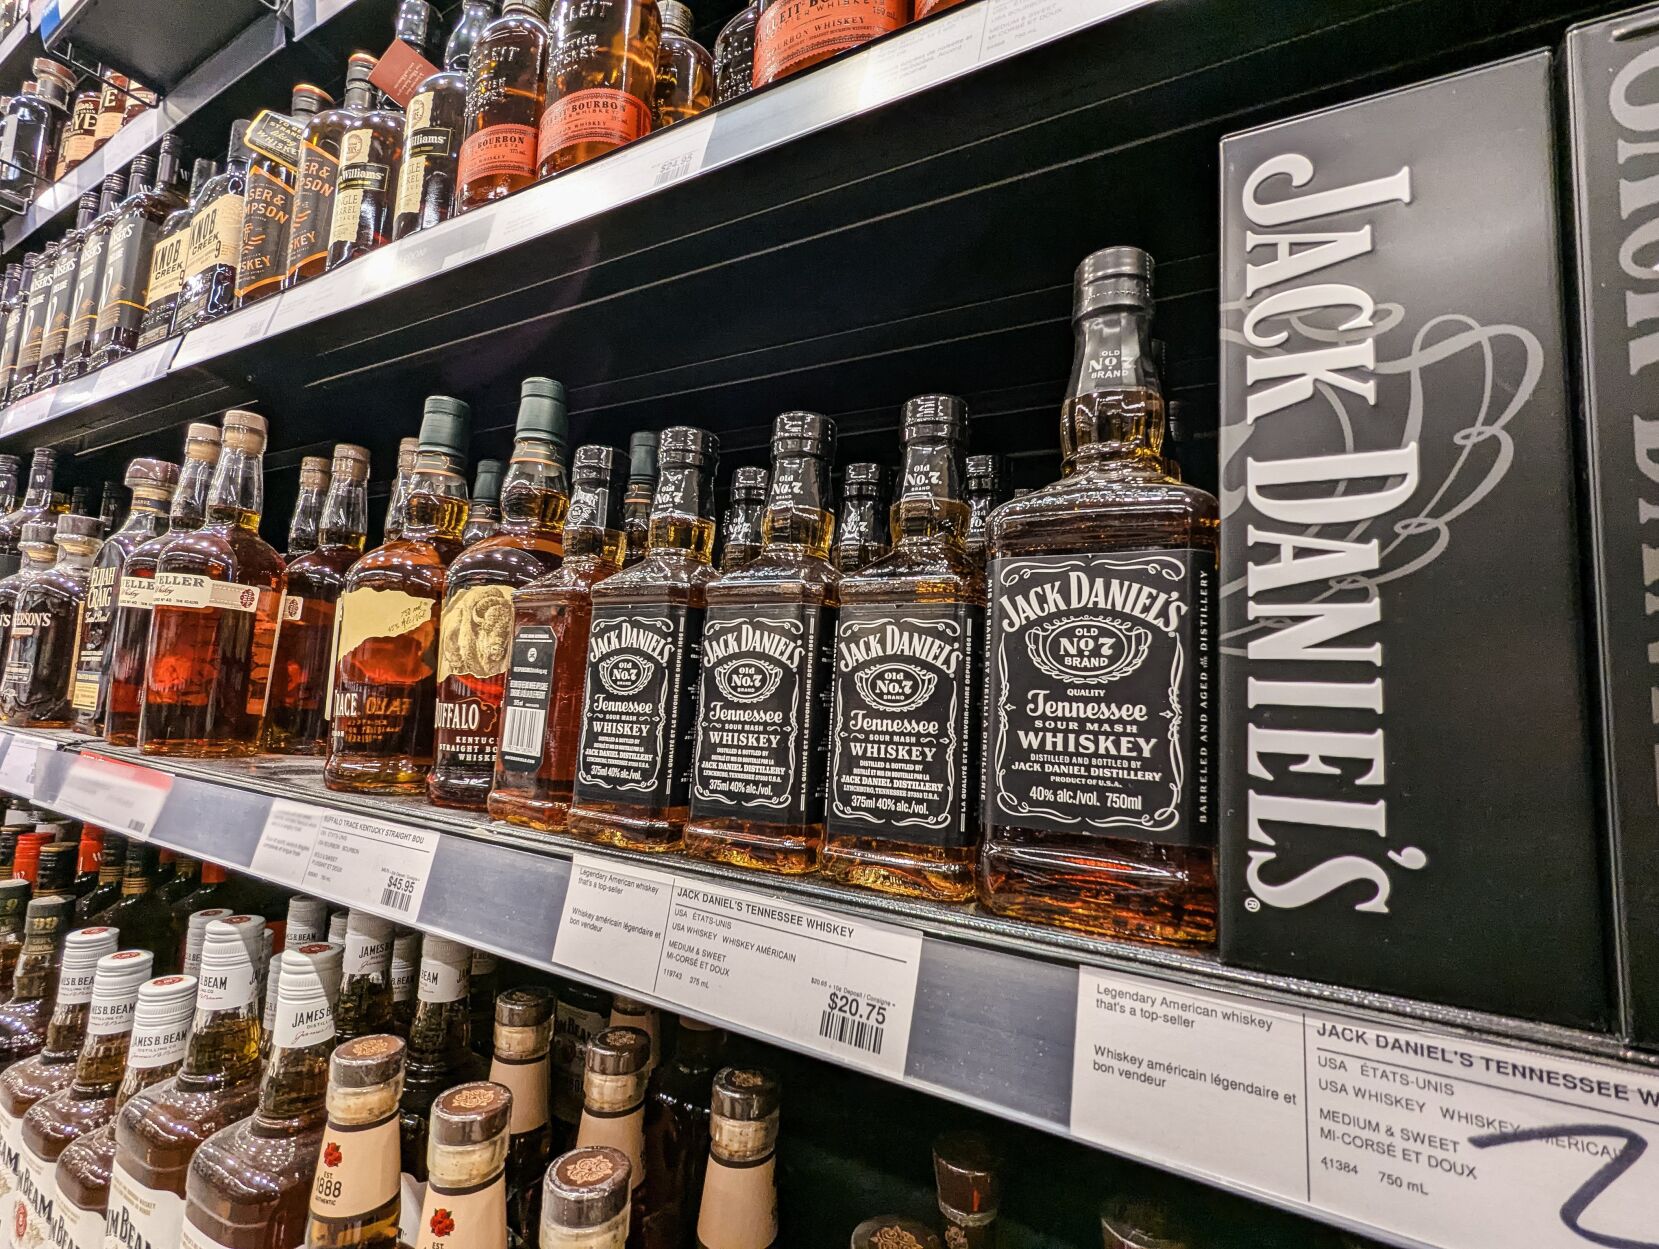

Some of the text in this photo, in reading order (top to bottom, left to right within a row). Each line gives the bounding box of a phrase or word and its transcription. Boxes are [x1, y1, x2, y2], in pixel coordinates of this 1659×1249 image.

[257, 130, 301, 155] WHISKE
[477, 136, 524, 148] BOURBON
[190, 207, 217, 245] KNOB
[192, 231, 218, 256] CREEK
[152, 239, 181, 274] KNOB
[155, 260, 183, 280] CREEK
[1091, 369, 1129, 379] BRAND
[914, 465, 930, 473] Old
[1242, 153, 1427, 913] JACK DANIEL'S
[91, 565, 116, 588] ELIJAH
[87, 586, 112, 611] CRAIG
[1000, 571, 1189, 633] JACK DANIEL'S
[1075, 627, 1098, 636] OLD
[590, 622, 675, 663] JACK DANIEL'S
[703, 624, 805, 668] JACK DANIEL'S
[840, 625, 963, 675] JACK DANIEL'S
[1064, 656, 1108, 667] BRAND
[730, 674, 763, 687] No.7
[884, 672, 904, 680] Old
[875, 680, 914, 694] No.7
[1067, 688, 1106, 697] QUALITY
[1200, 569, 1208, 823] BARRELED AND AGED DISTILLERY
[593, 694, 653, 714] Tennessee
[709, 702, 783, 723] Tennessee
[1026, 689, 1148, 721] Tennessee
[592, 721, 650, 736] WHISKEY
[849, 709, 939, 734] Tennessee
[1034, 720, 1138, 733] SOUR MASH
[709, 731, 781, 748] WHISKEY
[869, 733, 916, 743] SOUR MASH
[1017, 730, 1159, 758] WHISKEY
[458, 753, 497, 762] WHISKE
[849, 742, 936, 761] WHISKEY
[1030, 753, 1141, 768] DISTILLED AND BOTTLED BY
[1011, 761, 1162, 782] JACK DANIEL DISTILLERY
[1050, 775, 1087, 786] PRODUCT
[1087, 778, 1098, 786] OF
[709, 779, 729, 791] 375ml
[729, 780, 745, 793] 40%
[841, 774, 944, 792] JACK DANIEL DISTILLERY
[851, 794, 875, 808] 375ml
[876, 796, 895, 811] 40%
[1029, 785, 1142, 810] 40% alc./vol. 750ml
[343, 819, 360, 830] TRACE
[360, 823, 386, 836] KENTUCKY
[385, 828, 412, 842] STRAIGHT
[387, 875, 415, 893] $45.95
[579, 868, 659, 896] Legendary American whiskey
[598, 882, 624, 895] top-seller
[569, 916, 580, 925] bon
[571, 906, 595, 921] Whiskey
[674, 909, 732, 930] USA ÉTATS-UNIS
[677, 888, 854, 938] JACK DANIEL'S TENNESSEE WHISKEY
[298, 933, 316, 941] BEAM
[672, 922, 797, 963] USA WHISKEY WHISKEY AMÉRICAIN
[359, 943, 385, 958] JAMES
[669, 939, 726, 963] MEDIUM & SWEET
[666, 952, 730, 977] MI-CORSÉ ET DOUX
[204, 976, 228, 990] BEAM
[828, 992, 887, 1025] $20.75
[1095, 998, 1196, 1029] that's a top-seller
[1096, 983, 1273, 1032] Legendary American whiskey
[292, 1009, 325, 1028] JAMES
[163, 1030, 188, 1045] BEAM
[1316, 1022, 1369, 1046] JACK
[1375, 1035, 1474, 1068] DANIEL'S
[1480, 1053, 1630, 1102] TENNESSEE
[1093, 1059, 1167, 1088] bon vendeur
[1093, 1044, 1297, 1106] Whiskey américain légendaire et
[1317, 1054, 1455, 1097] USA ÉTATS-UNIS
[1318, 1077, 1522, 1135] USA WHISKEY WHISKEY
[1319, 1107, 1461, 1154] MEDIUM & SWEET
[1319, 1126, 1478, 1181] MI-CORSÉ ET DOUX
[1320, 1156, 1429, 1196] 41384 750 mL
